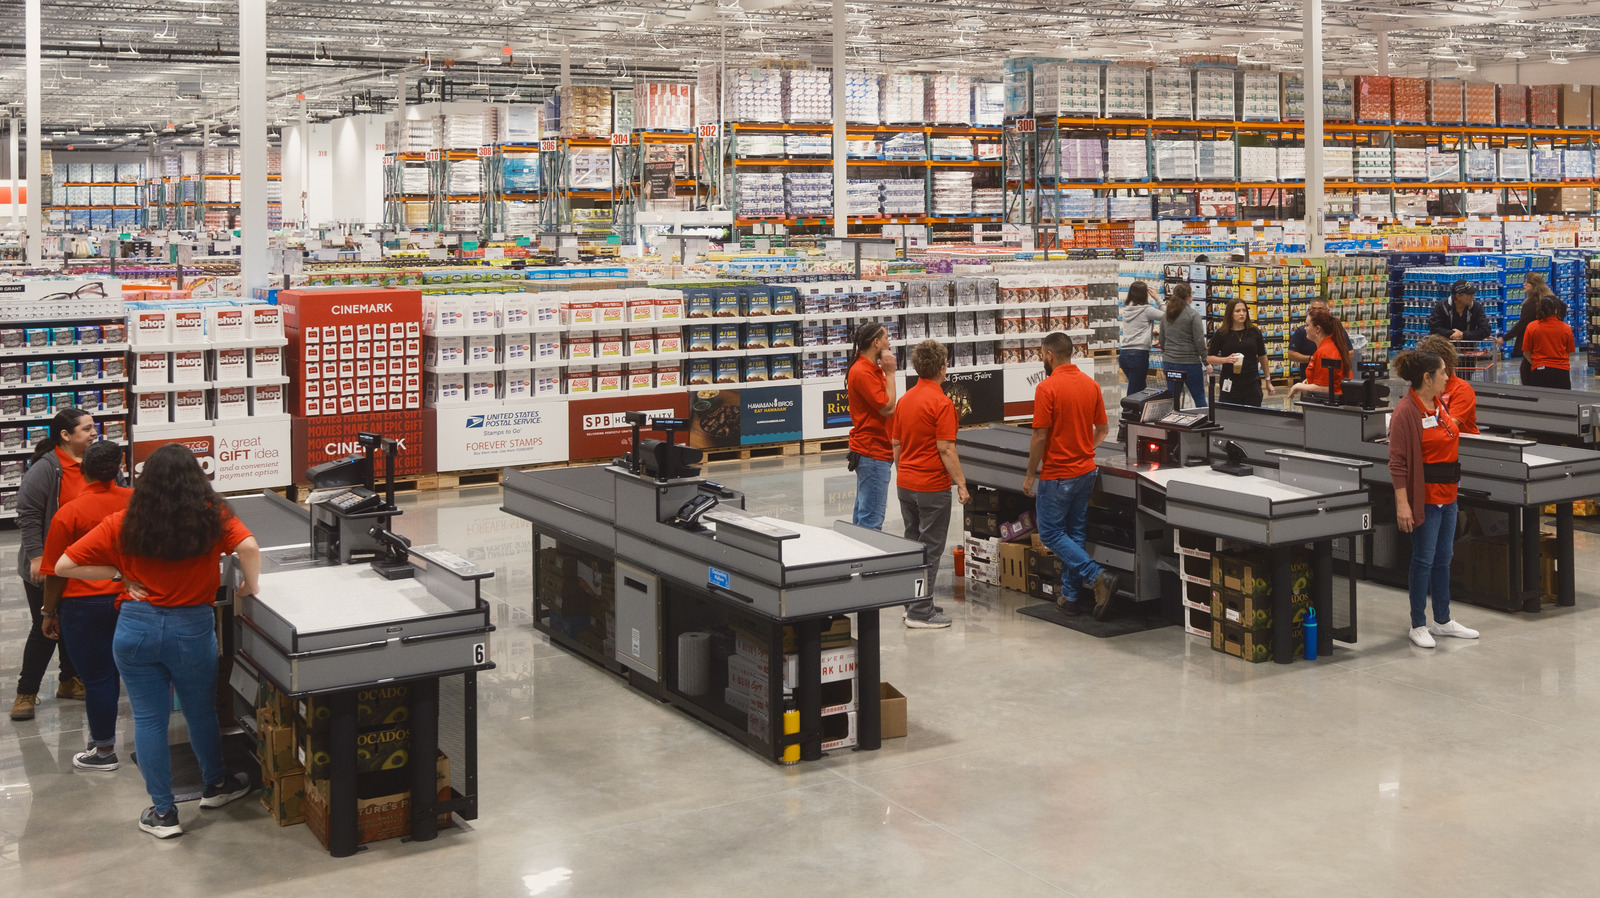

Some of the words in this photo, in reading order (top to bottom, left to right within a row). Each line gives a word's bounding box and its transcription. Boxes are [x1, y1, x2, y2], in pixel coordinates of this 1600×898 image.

[700, 126, 716, 136] 302
[1018, 120, 1034, 132] 300
[613, 134, 628, 144] 304
[542, 140, 555, 151] 306
[426, 152, 438, 160] 310
[478, 146, 492, 156] 308
[332, 303, 393, 314] CINEMARK
[176, 317, 201, 327] shop
[218, 315, 242, 326] shop
[254, 313, 278, 323] shop
[140, 319, 165, 329] shop
[176, 357, 201, 367] shop
[220, 355, 244, 365] shop
[256, 352, 279, 362] shop
[140, 359, 166, 369] shop
[952, 374, 972, 383] Forest
[974, 372, 992, 381] Faire
[221, 394, 245, 403] shop
[257, 391, 280, 400] shop
[141, 398, 166, 408] shop
[178, 396, 202, 406] shop
[485, 419, 511, 427] POSTAL
[513, 417, 541, 425] SERVICE
[585, 416, 610, 427] SPB
[308, 426, 342, 437] MOVIES
[344, 422, 368, 435] MAKE
[370, 422, 382, 432] AN
[384, 421, 402, 432] EPIC
[404, 420, 423, 431] GIFT
[219, 438, 228, 448] A
[232, 436, 261, 450] great
[466, 440, 505, 451] FOREVER
[510, 437, 543, 447] STAMPS
[219, 450, 250, 461] GIFT
[254, 448, 279, 458] idea
[404, 456, 423, 468] GIFT
[220, 471, 253, 480] payment
[255, 469, 278, 477] option
[1364, 514, 1368, 528] 8
[917, 580, 923, 596] 7
[475, 645, 483, 663] 6
